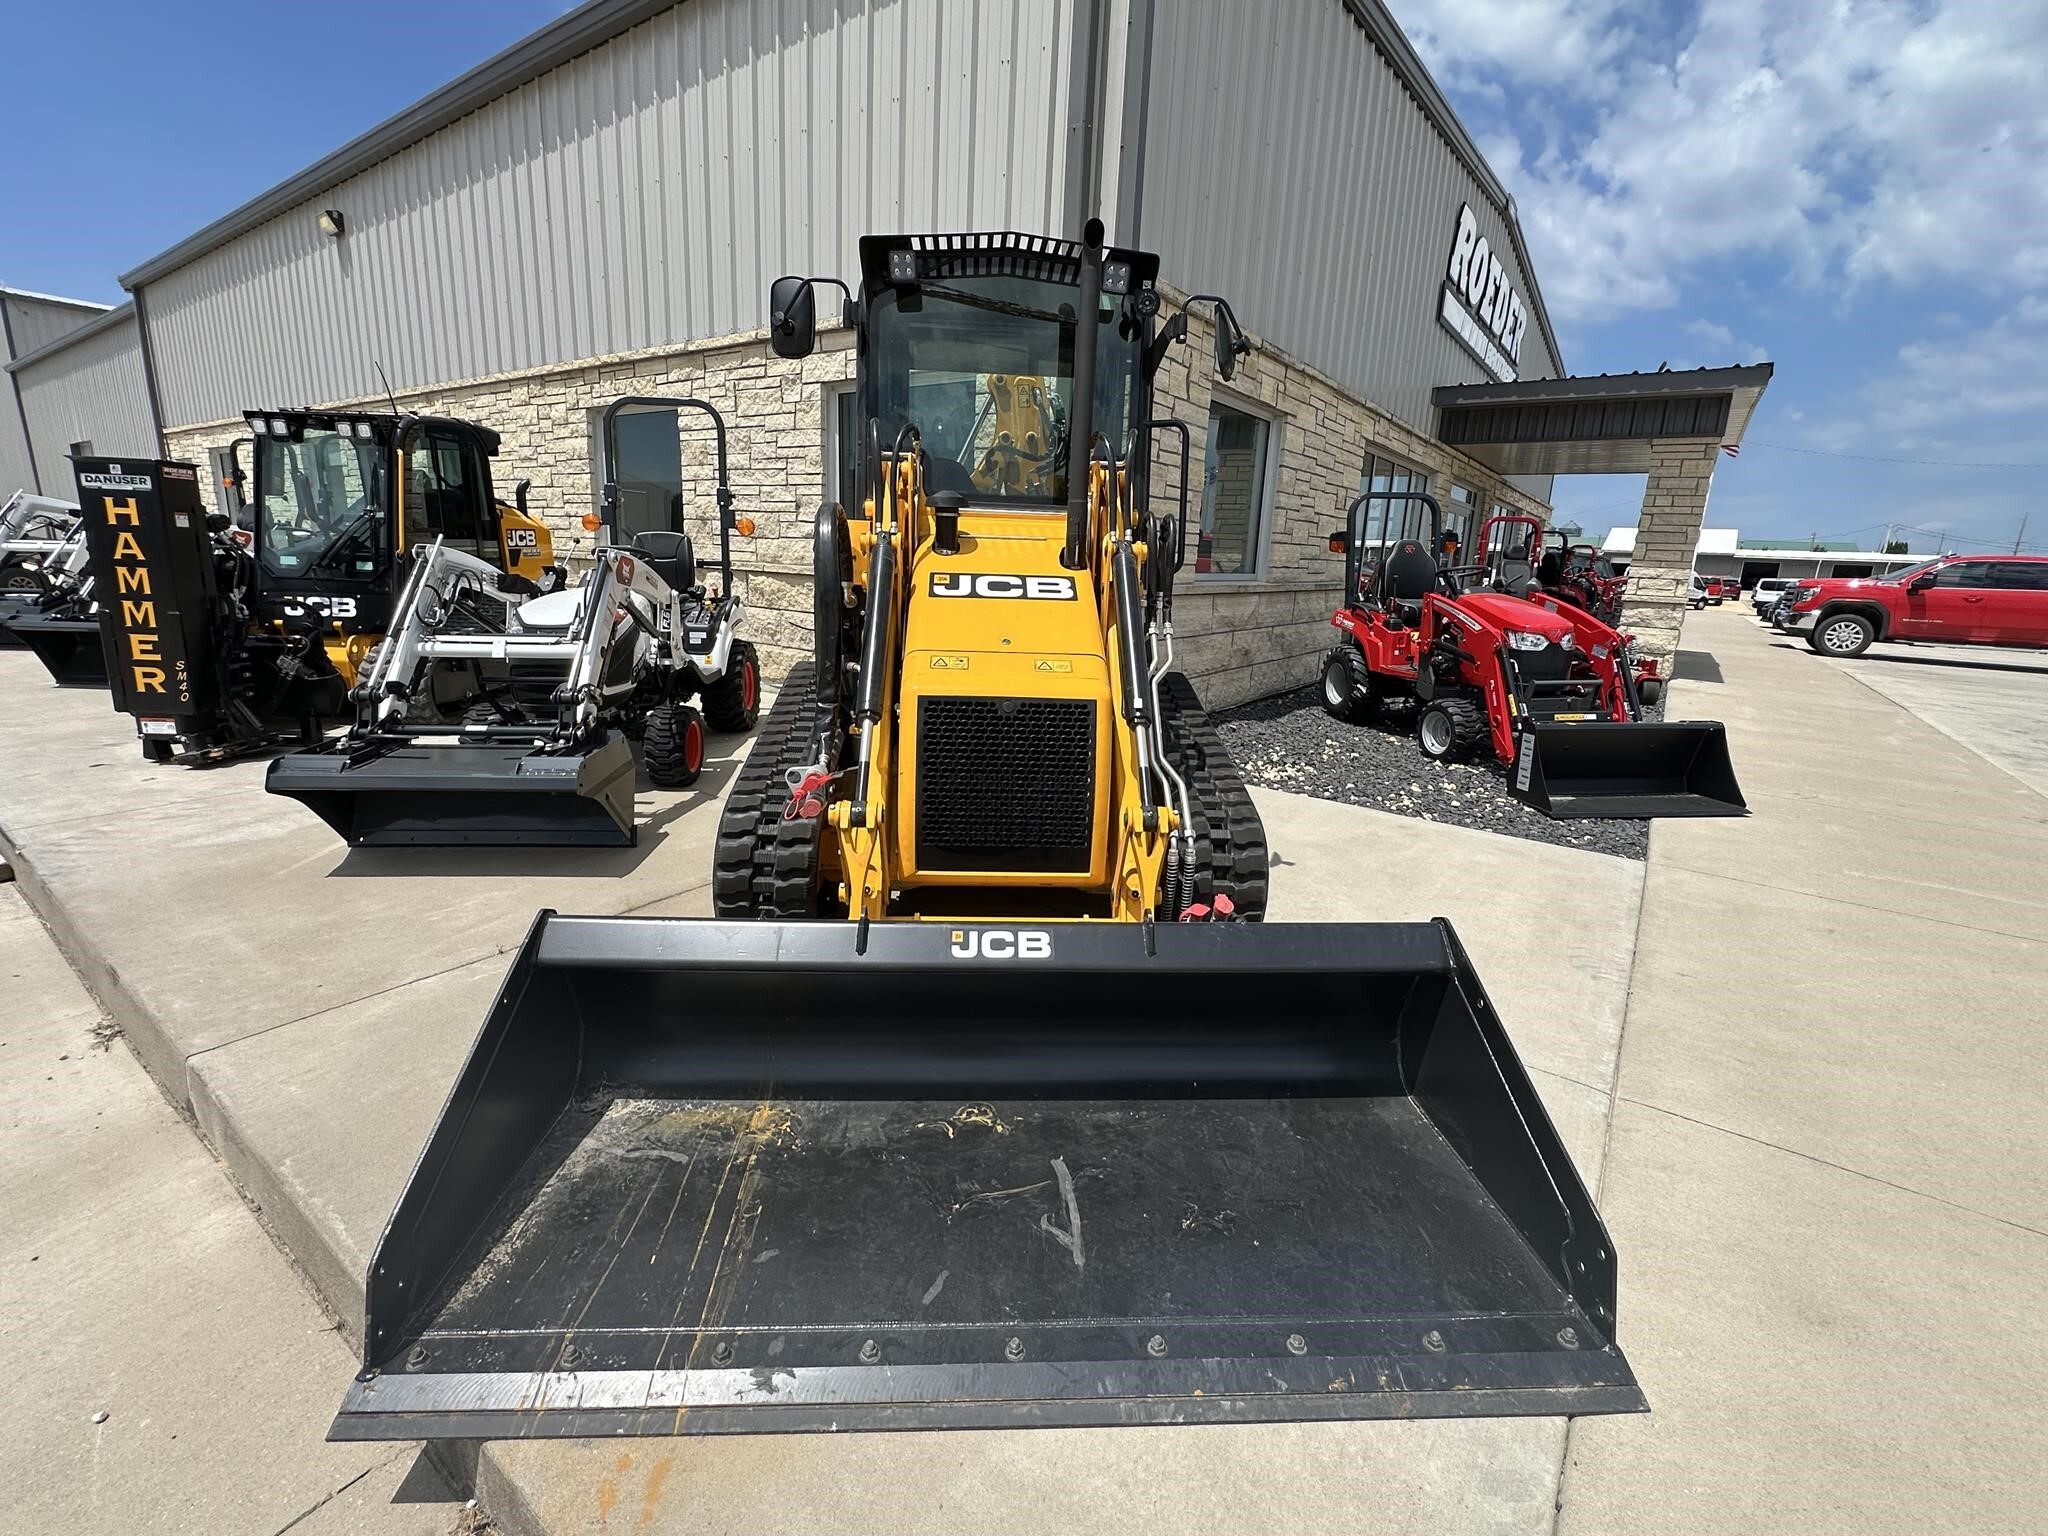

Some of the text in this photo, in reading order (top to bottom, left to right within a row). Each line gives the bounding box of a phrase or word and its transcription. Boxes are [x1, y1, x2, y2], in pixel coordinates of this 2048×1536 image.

[1449, 203, 1527, 364] ROEDER
[84, 474, 148, 485] DANUSER
[507, 529, 536, 546] JCB
[102, 496, 167, 693] HAMMER
[932, 574, 1075, 600] JCB
[283, 595, 357, 618] JCB
[175, 660, 190, 702] SM40
[951, 930, 1052, 959] JCB
